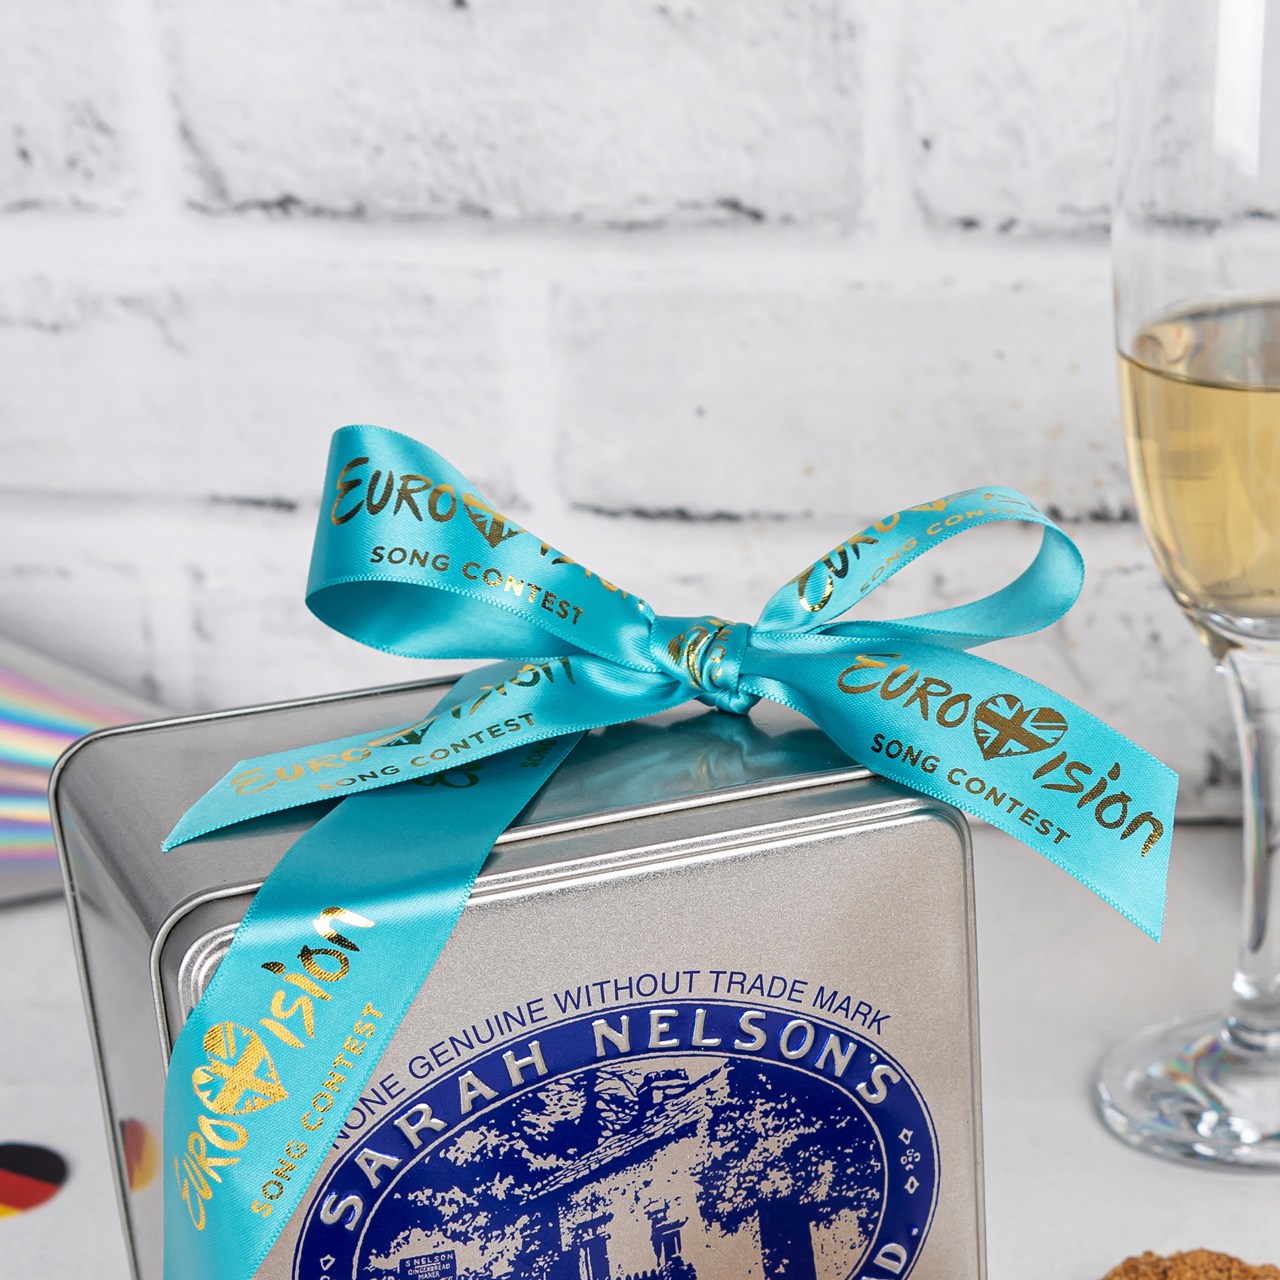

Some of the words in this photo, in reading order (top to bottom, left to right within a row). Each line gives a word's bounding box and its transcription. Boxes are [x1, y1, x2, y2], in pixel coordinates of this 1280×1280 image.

[370, 546, 451, 572] SONG
[462, 562, 585, 626] CONTEST
[860, 537, 917, 594] SONG
[318, 764, 401, 792] SONG
[410, 712, 534, 767] CONTEST
[871, 733, 940, 774] SONG
[947, 768, 1071, 846] CONTEST
[408, 998, 549, 1080] GENUINE
[553, 970, 701, 1014] WITHOUT
[709, 970, 809, 1002] TRADE
[812, 985, 892, 1036] MARK
[251, 1139, 308, 1218] SONG
[302, 1002, 384, 1132] CONTEST
[320, 1040, 549, 1231] SARAH
[591, 1007, 901, 1106] NELSON'S
[413, 1253, 454, 1266] NELSON
